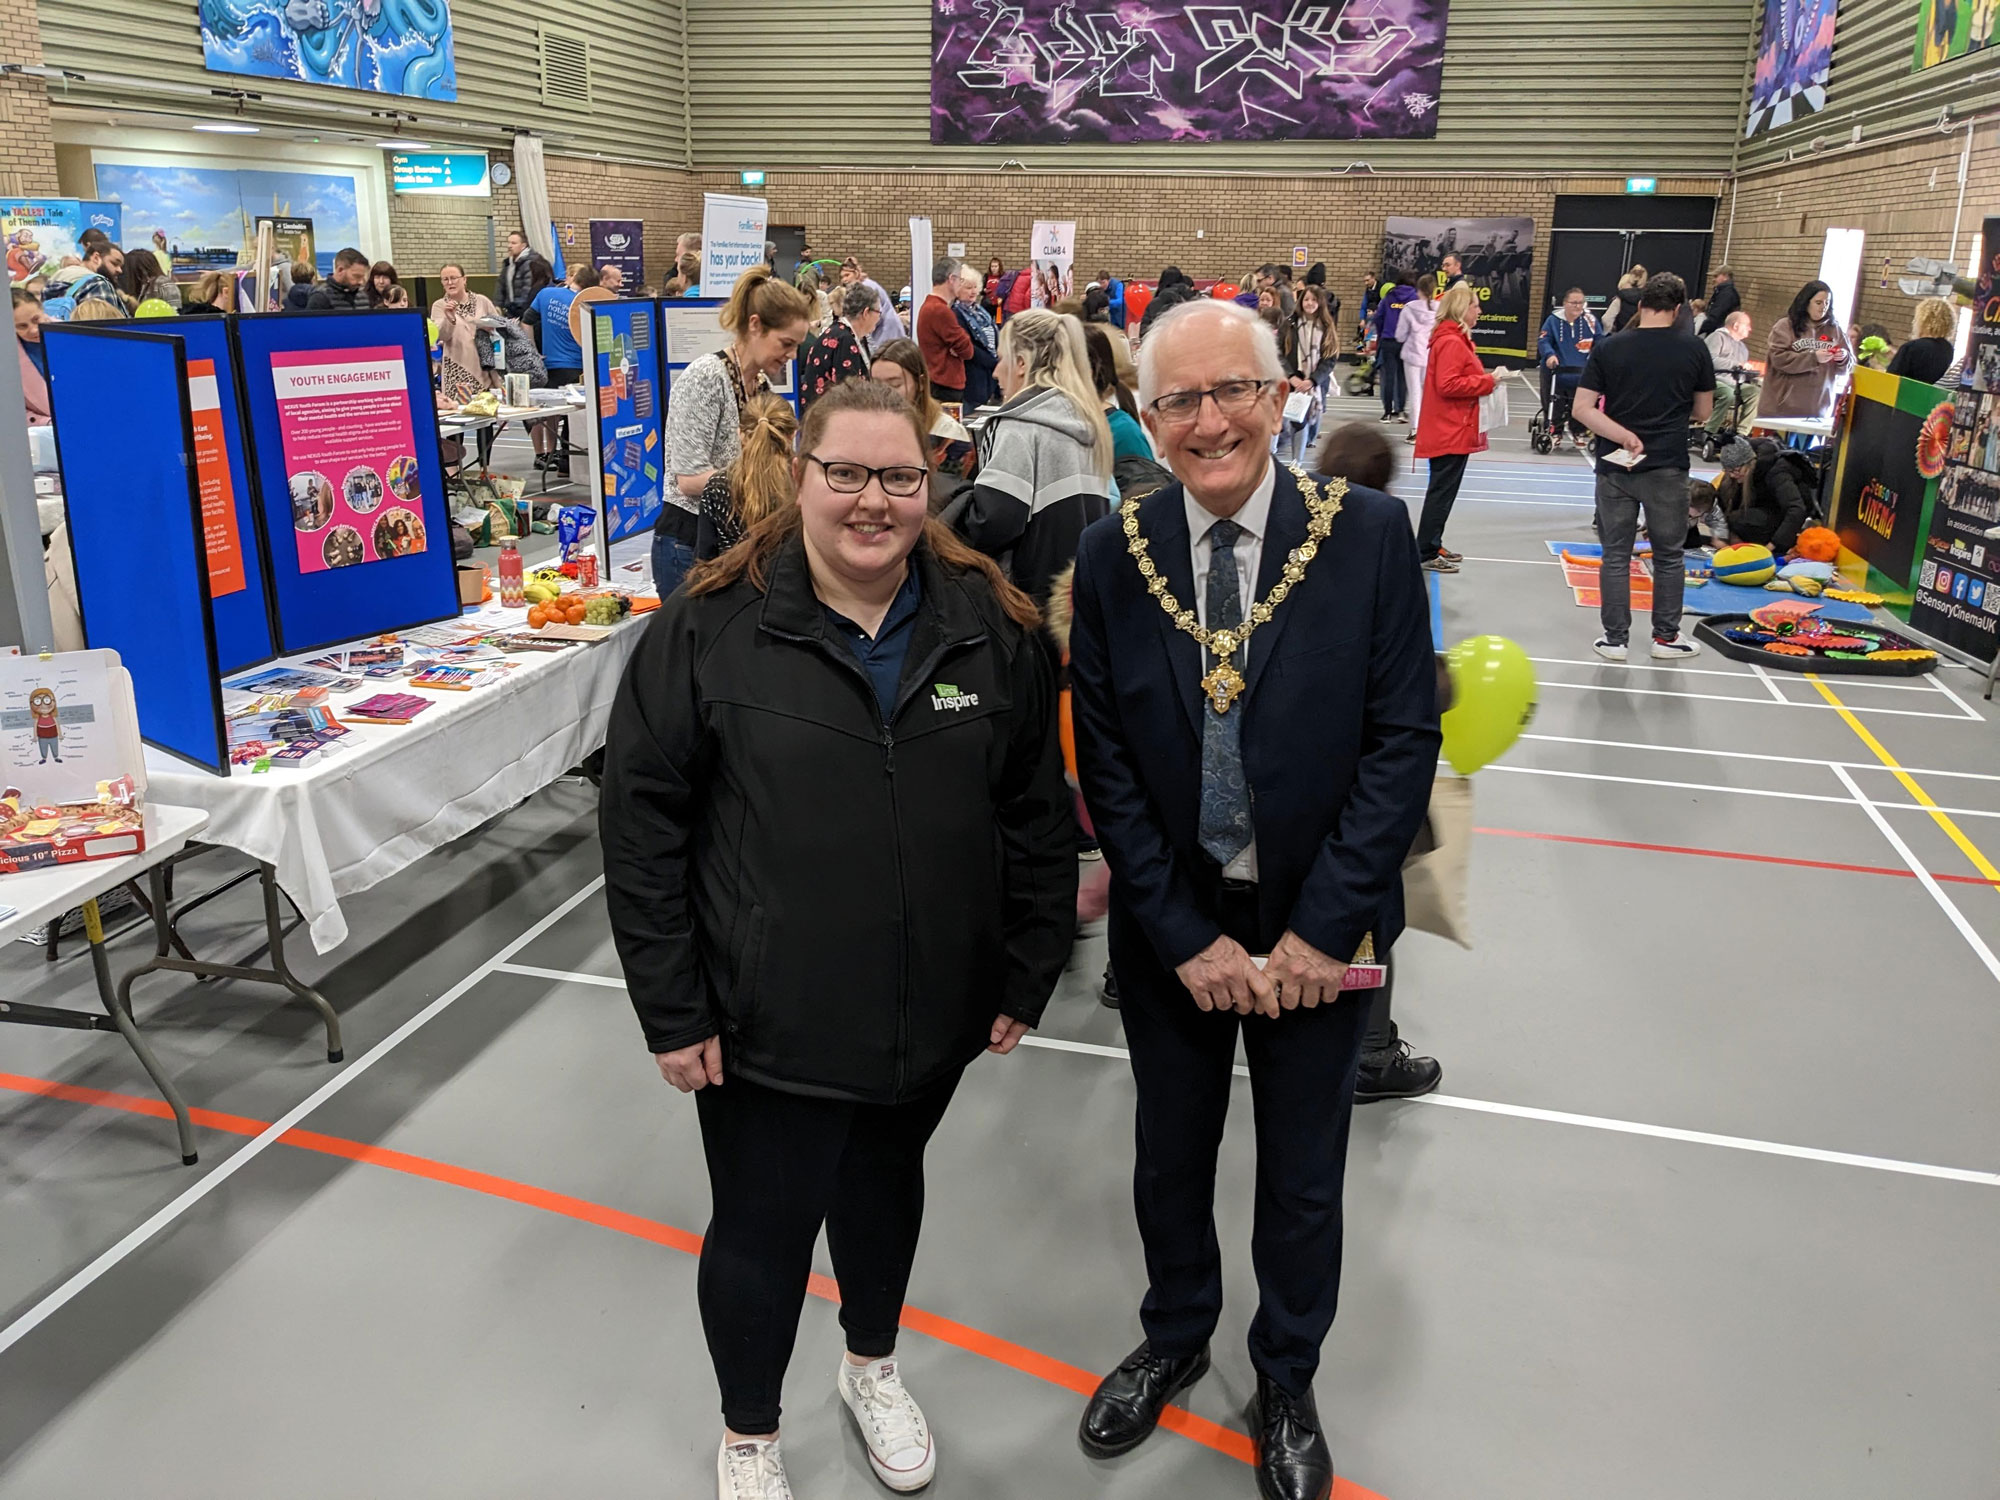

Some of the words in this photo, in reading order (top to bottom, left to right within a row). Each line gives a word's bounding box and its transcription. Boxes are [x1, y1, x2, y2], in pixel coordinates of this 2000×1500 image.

[393, 166, 414, 174] Group
[12, 208, 45, 216] TALLEST
[48, 208, 64, 216] Tale
[8, 218, 17, 226] of
[1044, 246, 1061, 255] CLIMB
[710, 250, 723, 265] has
[725, 254, 739, 269] your
[741, 251, 761, 266] back!
[290, 375, 325, 386] YOUTH
[327, 371, 391, 384] ENGAGEMENT
[1953, 521, 1983, 536] association
[1950, 544, 1972, 561] Inspire
[1916, 589, 1997, 634] @SensoryCinemaUK
[931, 691, 979, 712] Inspire
[0, 856, 30, 864] icious
[51, 848, 78, 859] Pizza
